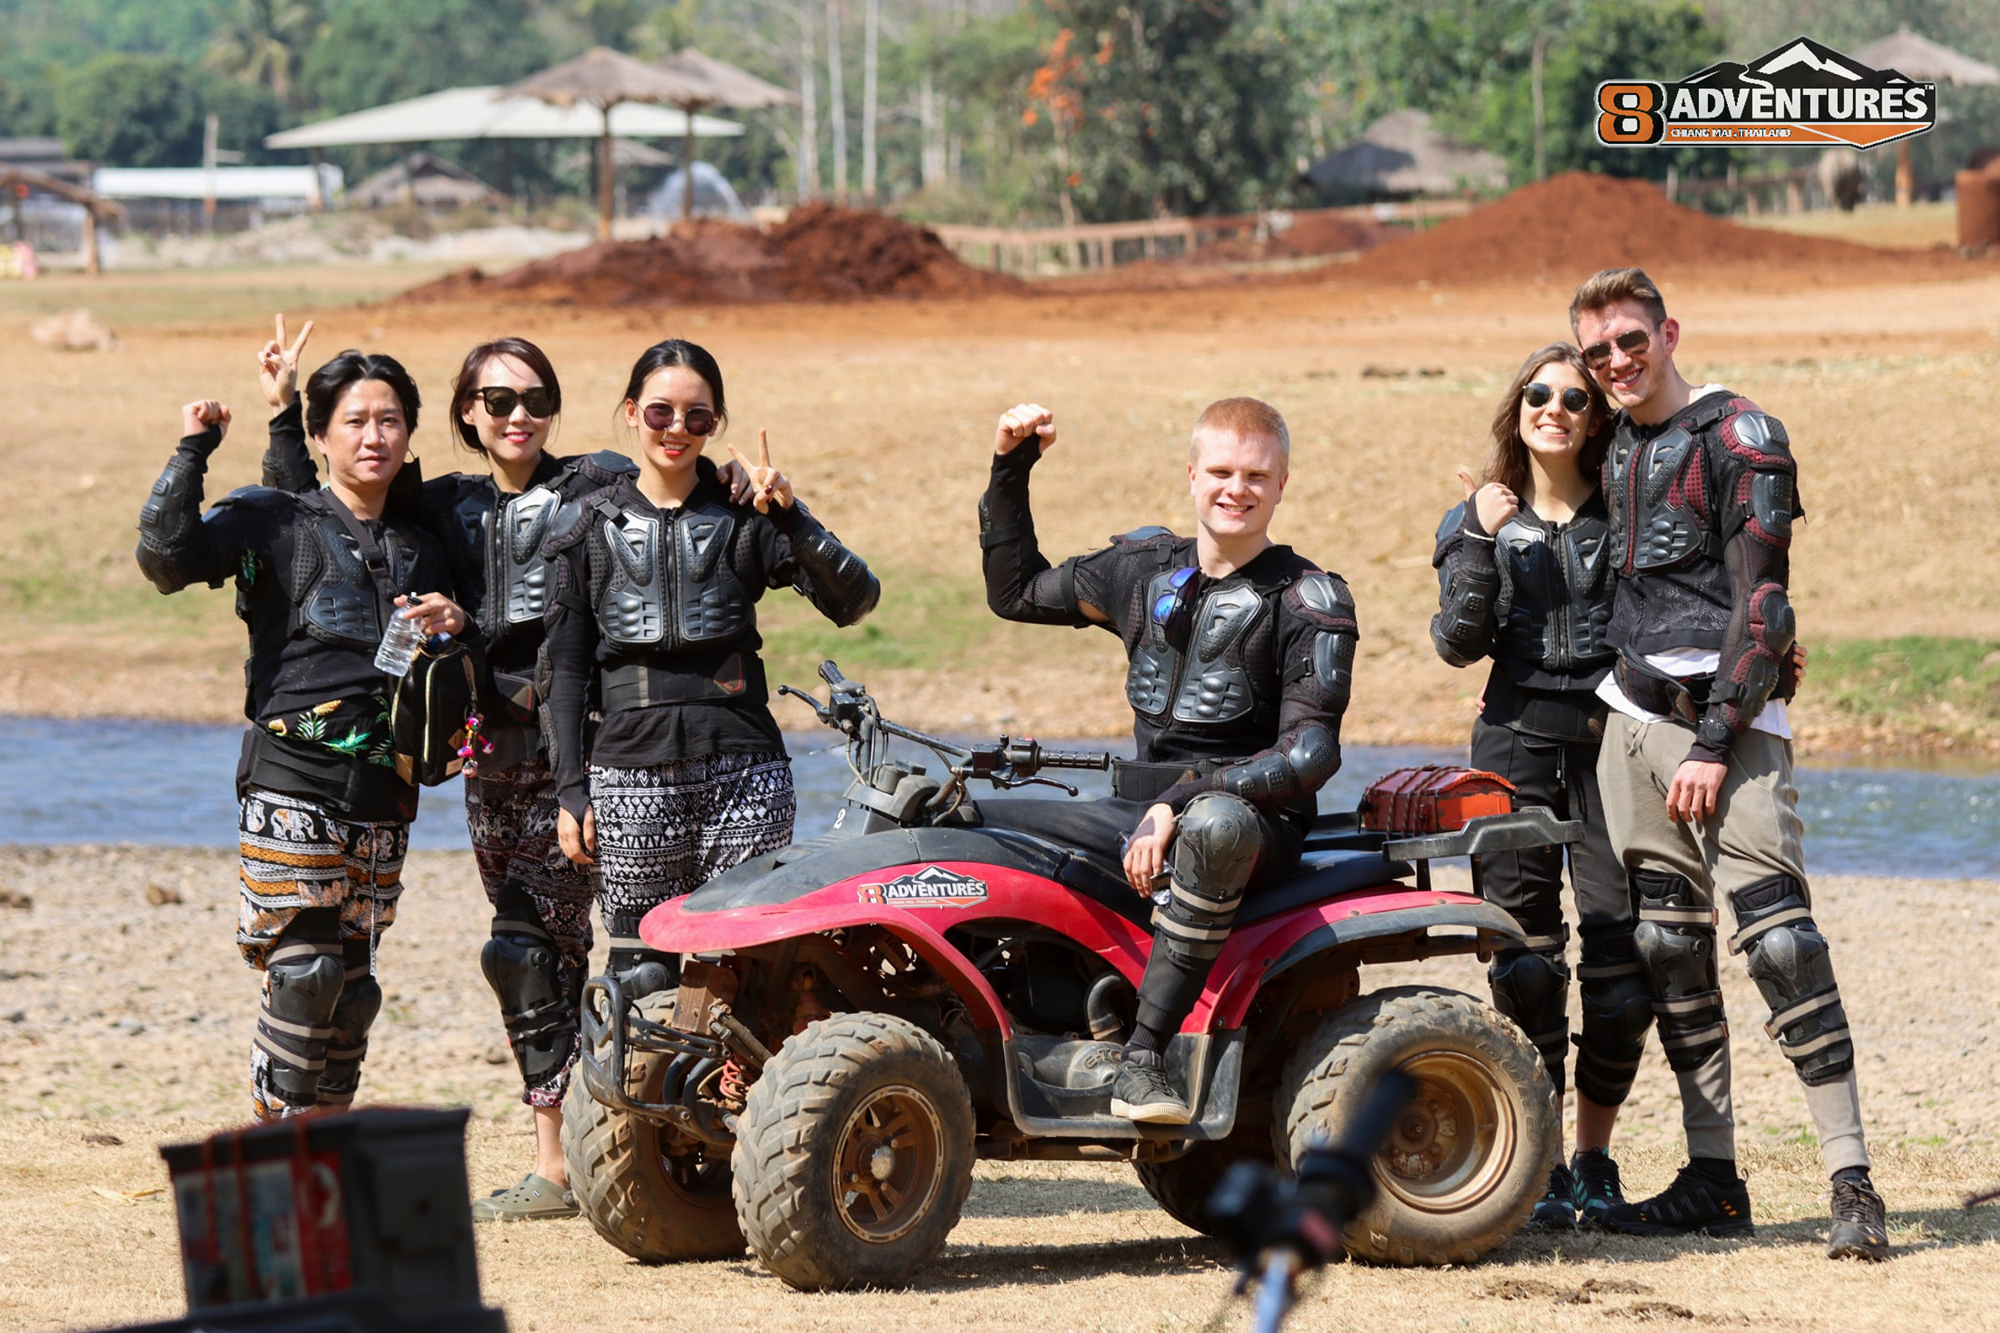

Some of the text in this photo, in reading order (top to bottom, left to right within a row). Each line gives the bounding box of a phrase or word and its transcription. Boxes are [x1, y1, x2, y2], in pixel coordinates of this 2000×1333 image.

[833, 808, 846, 830] 2
[858, 881, 985, 904] 8 ADVENTURES
[1083, 1048, 1121, 1070] E-TO
